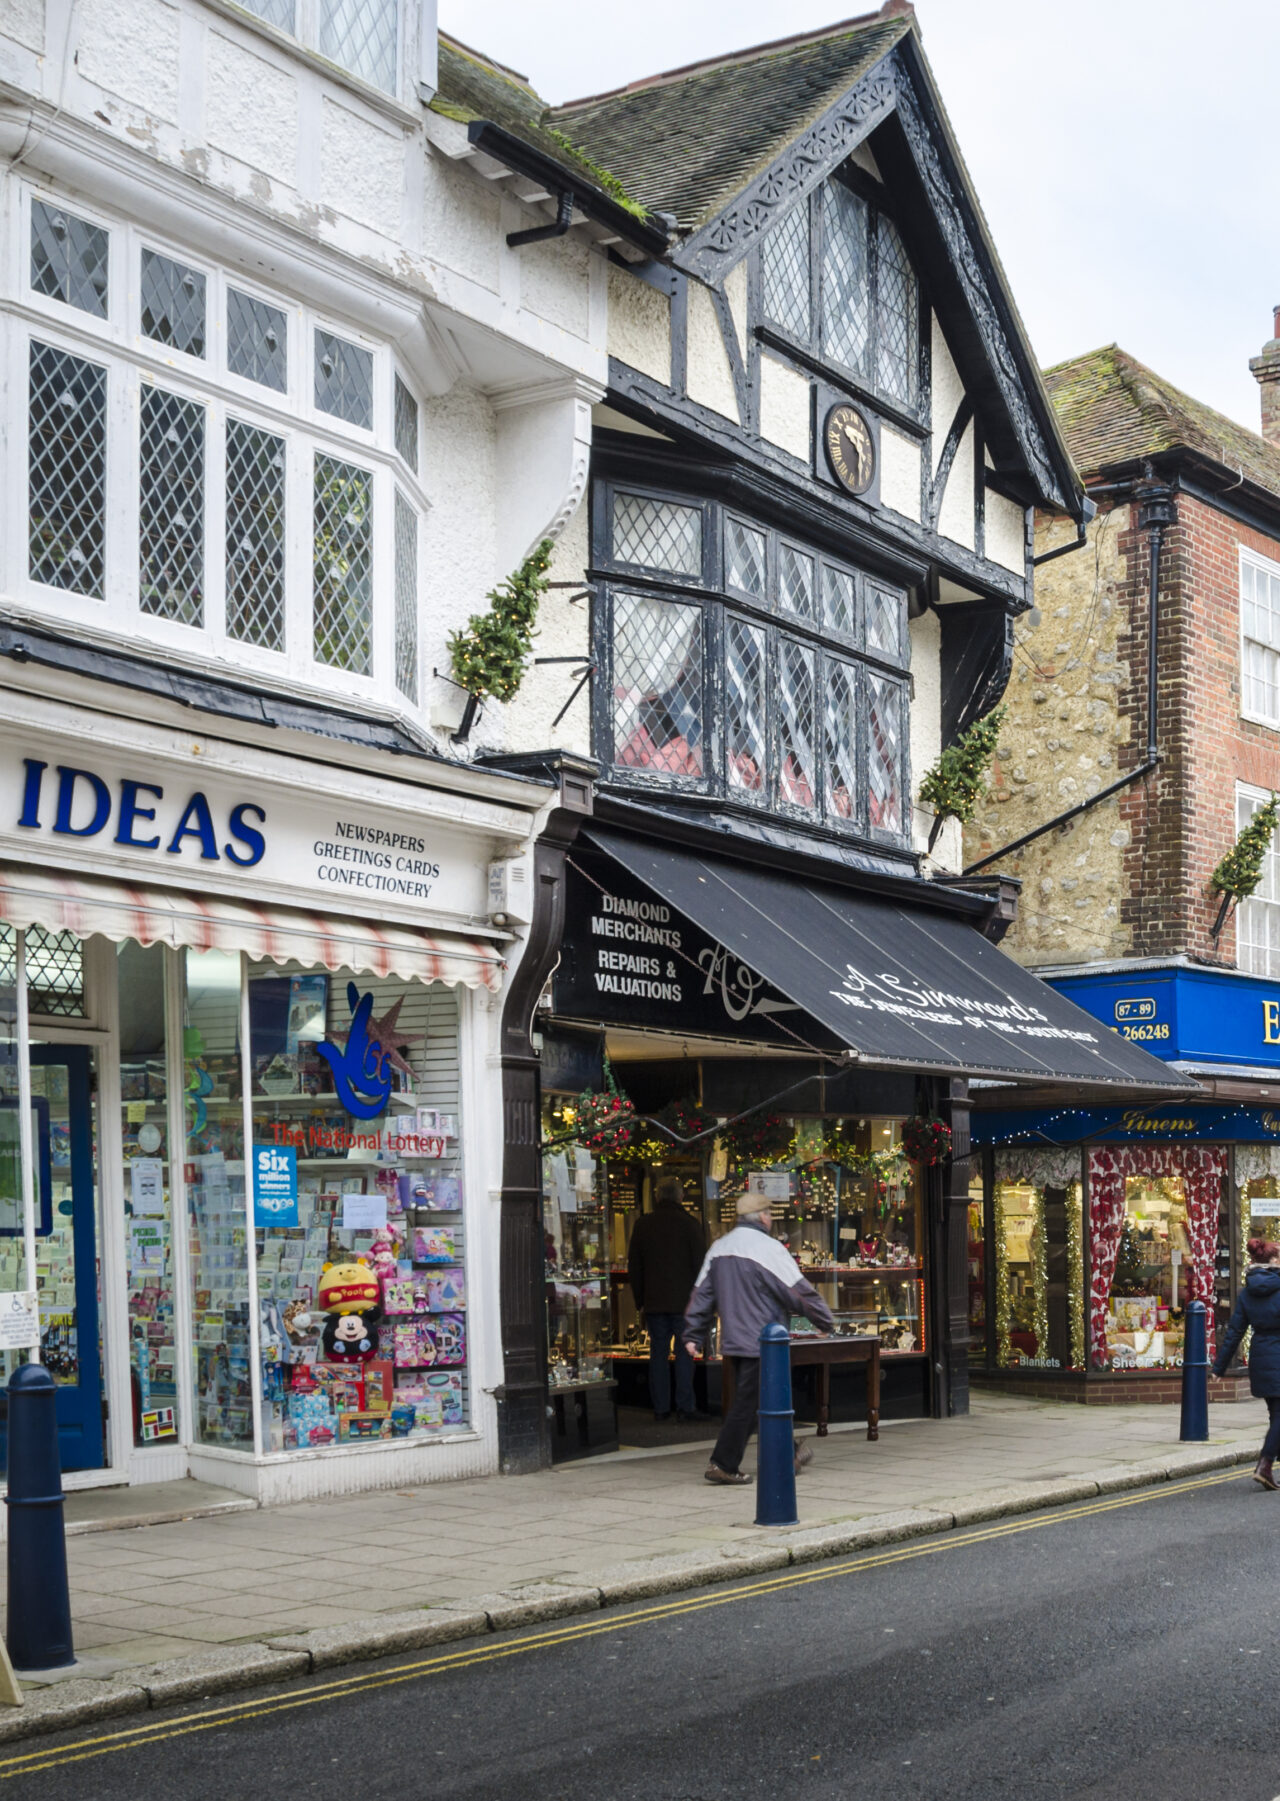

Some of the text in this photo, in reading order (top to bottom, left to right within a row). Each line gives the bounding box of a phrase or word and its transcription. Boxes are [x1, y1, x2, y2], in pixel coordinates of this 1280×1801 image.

[17, 758, 267, 867] IDEAS
[335, 821, 425, 853] NEWSPAPERS
[313, 841, 440, 878] GREETINGS CARDS
[317, 865, 432, 898] CONFECTIONERY
[602, 894, 670, 923] DIAMOND
[591, 916, 682, 948] MERCHANTS
[598, 950, 677, 978] REPAIRS &
[594, 973, 682, 1002] VALUATIONS
[876, 973, 1049, 1023] Simmonds
[829, 990, 1099, 1043] THE JEWELLERS OF THE SOUTH EAST
[1123, 1024, 1170, 1041] 266248
[1118, 1109, 1198, 1134] Linens
[270, 1123, 445, 1158] The National Lottery
[258, 1149, 290, 1171] Six
[258, 1171, 290, 1182] million
[1019, 1356, 1060, 1368] Blankets
